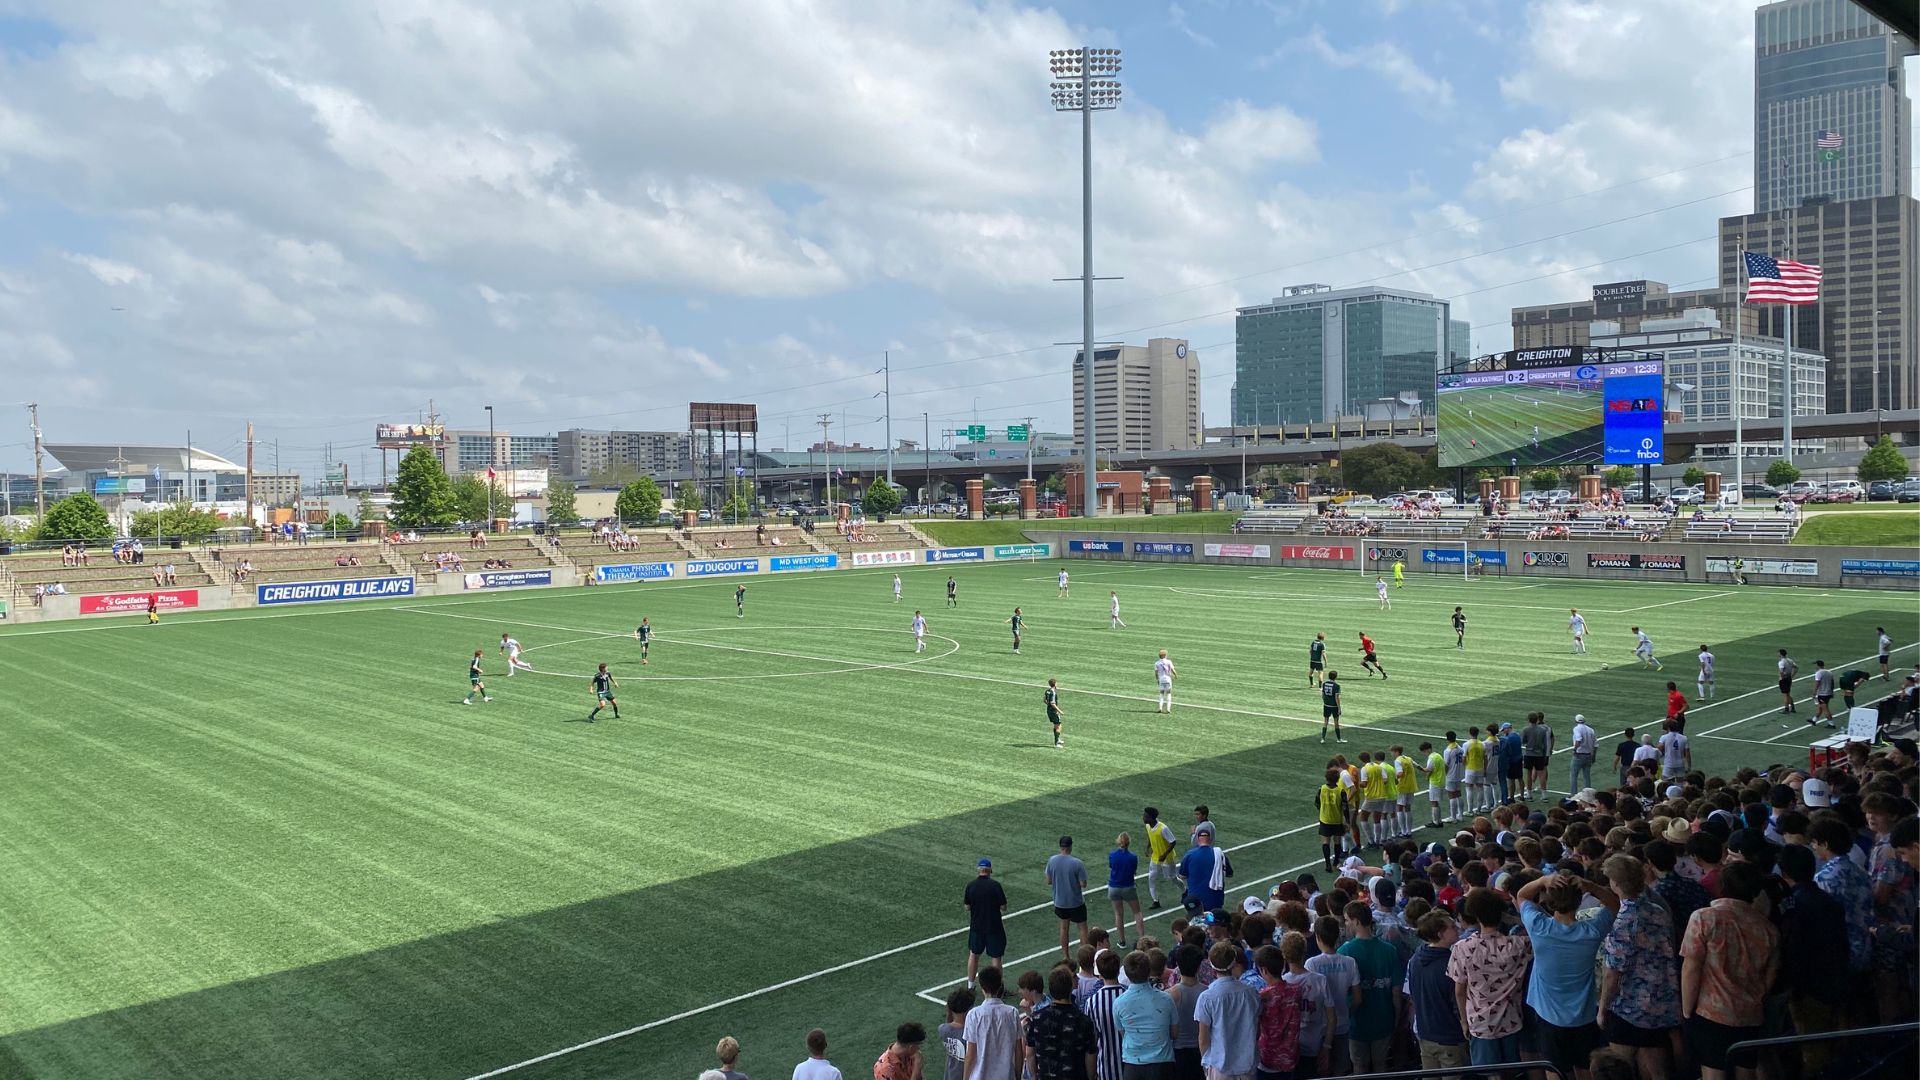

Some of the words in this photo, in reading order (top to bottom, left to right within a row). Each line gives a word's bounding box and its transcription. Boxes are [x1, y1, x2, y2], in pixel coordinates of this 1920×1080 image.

[1516, 349, 1572, 361] CREIGHTON
[1610, 367, 1627, 376] 2ND
[814, 556, 829, 564] ONE
[1599, 560, 1631, 568] OMAHA
[631, 563, 664, 572] PHYSICAL
[705, 560, 743, 571] DUGOUT
[1647, 561, 1682, 569] OMAHA
[264, 584, 341, 601] CREIGHTON
[342, 579, 411, 597] BLUEJAYS
[1673, 740, 1679, 751] 4
